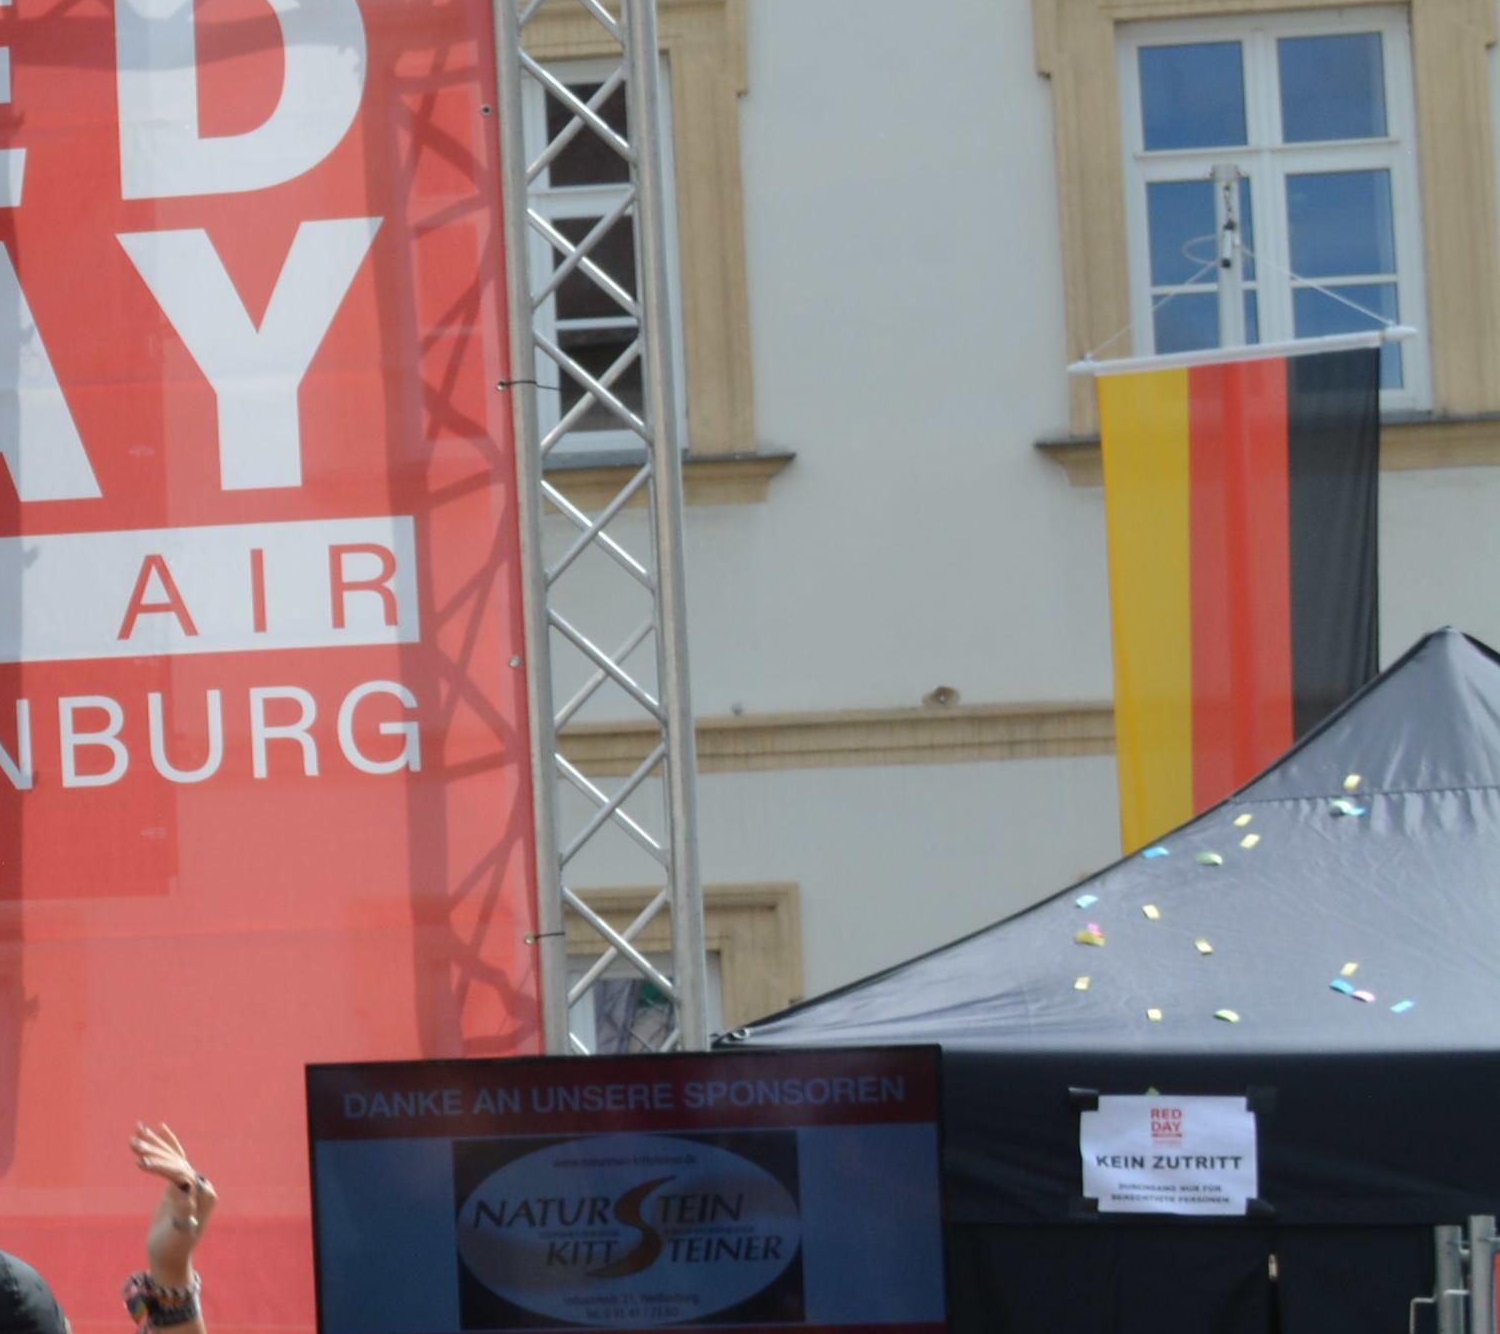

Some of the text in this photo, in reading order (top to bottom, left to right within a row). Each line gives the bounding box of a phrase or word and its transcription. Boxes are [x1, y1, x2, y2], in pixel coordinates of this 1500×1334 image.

[117, 541, 402, 643] AIR
[343, 1075, 906, 1119] DANKE AN UNSERE SPONSOREN
[1150, 1108, 1182, 1120] RED
[1151, 1121, 1182, 1133] DAY
[1095, 1155, 1242, 1169] KEIN ZUTRITT
